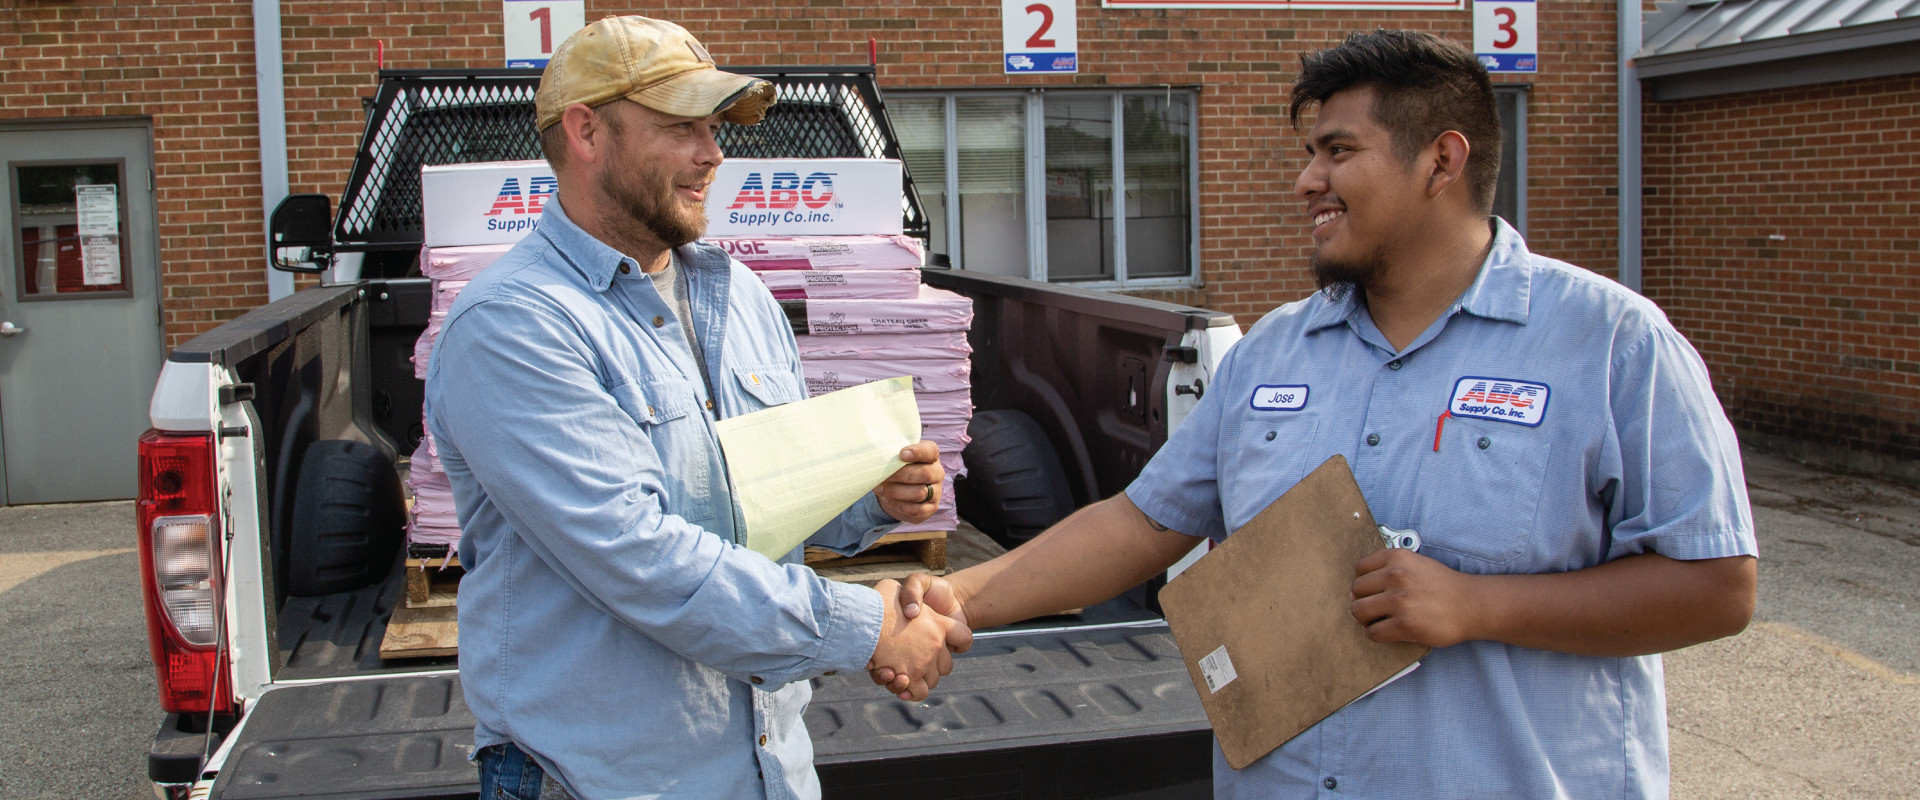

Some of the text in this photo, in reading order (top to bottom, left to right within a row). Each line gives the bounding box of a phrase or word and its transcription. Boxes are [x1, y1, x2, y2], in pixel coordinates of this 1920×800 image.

[529, 7, 552, 54] 1
[1025, 3, 1056, 48] 2
[1493, 7, 1518, 49] 3
[483, 176, 558, 216] AB
[726, 172, 838, 209] ABC
[487, 217, 538, 232] Supply
[729, 212, 780, 226] Supply
[713, 240, 769, 255] DGE
[1268, 392, 1294, 403] Jose
[1457, 382, 1544, 407] ABC
[1460, 403, 1526, 419] Supply Co. inc.
